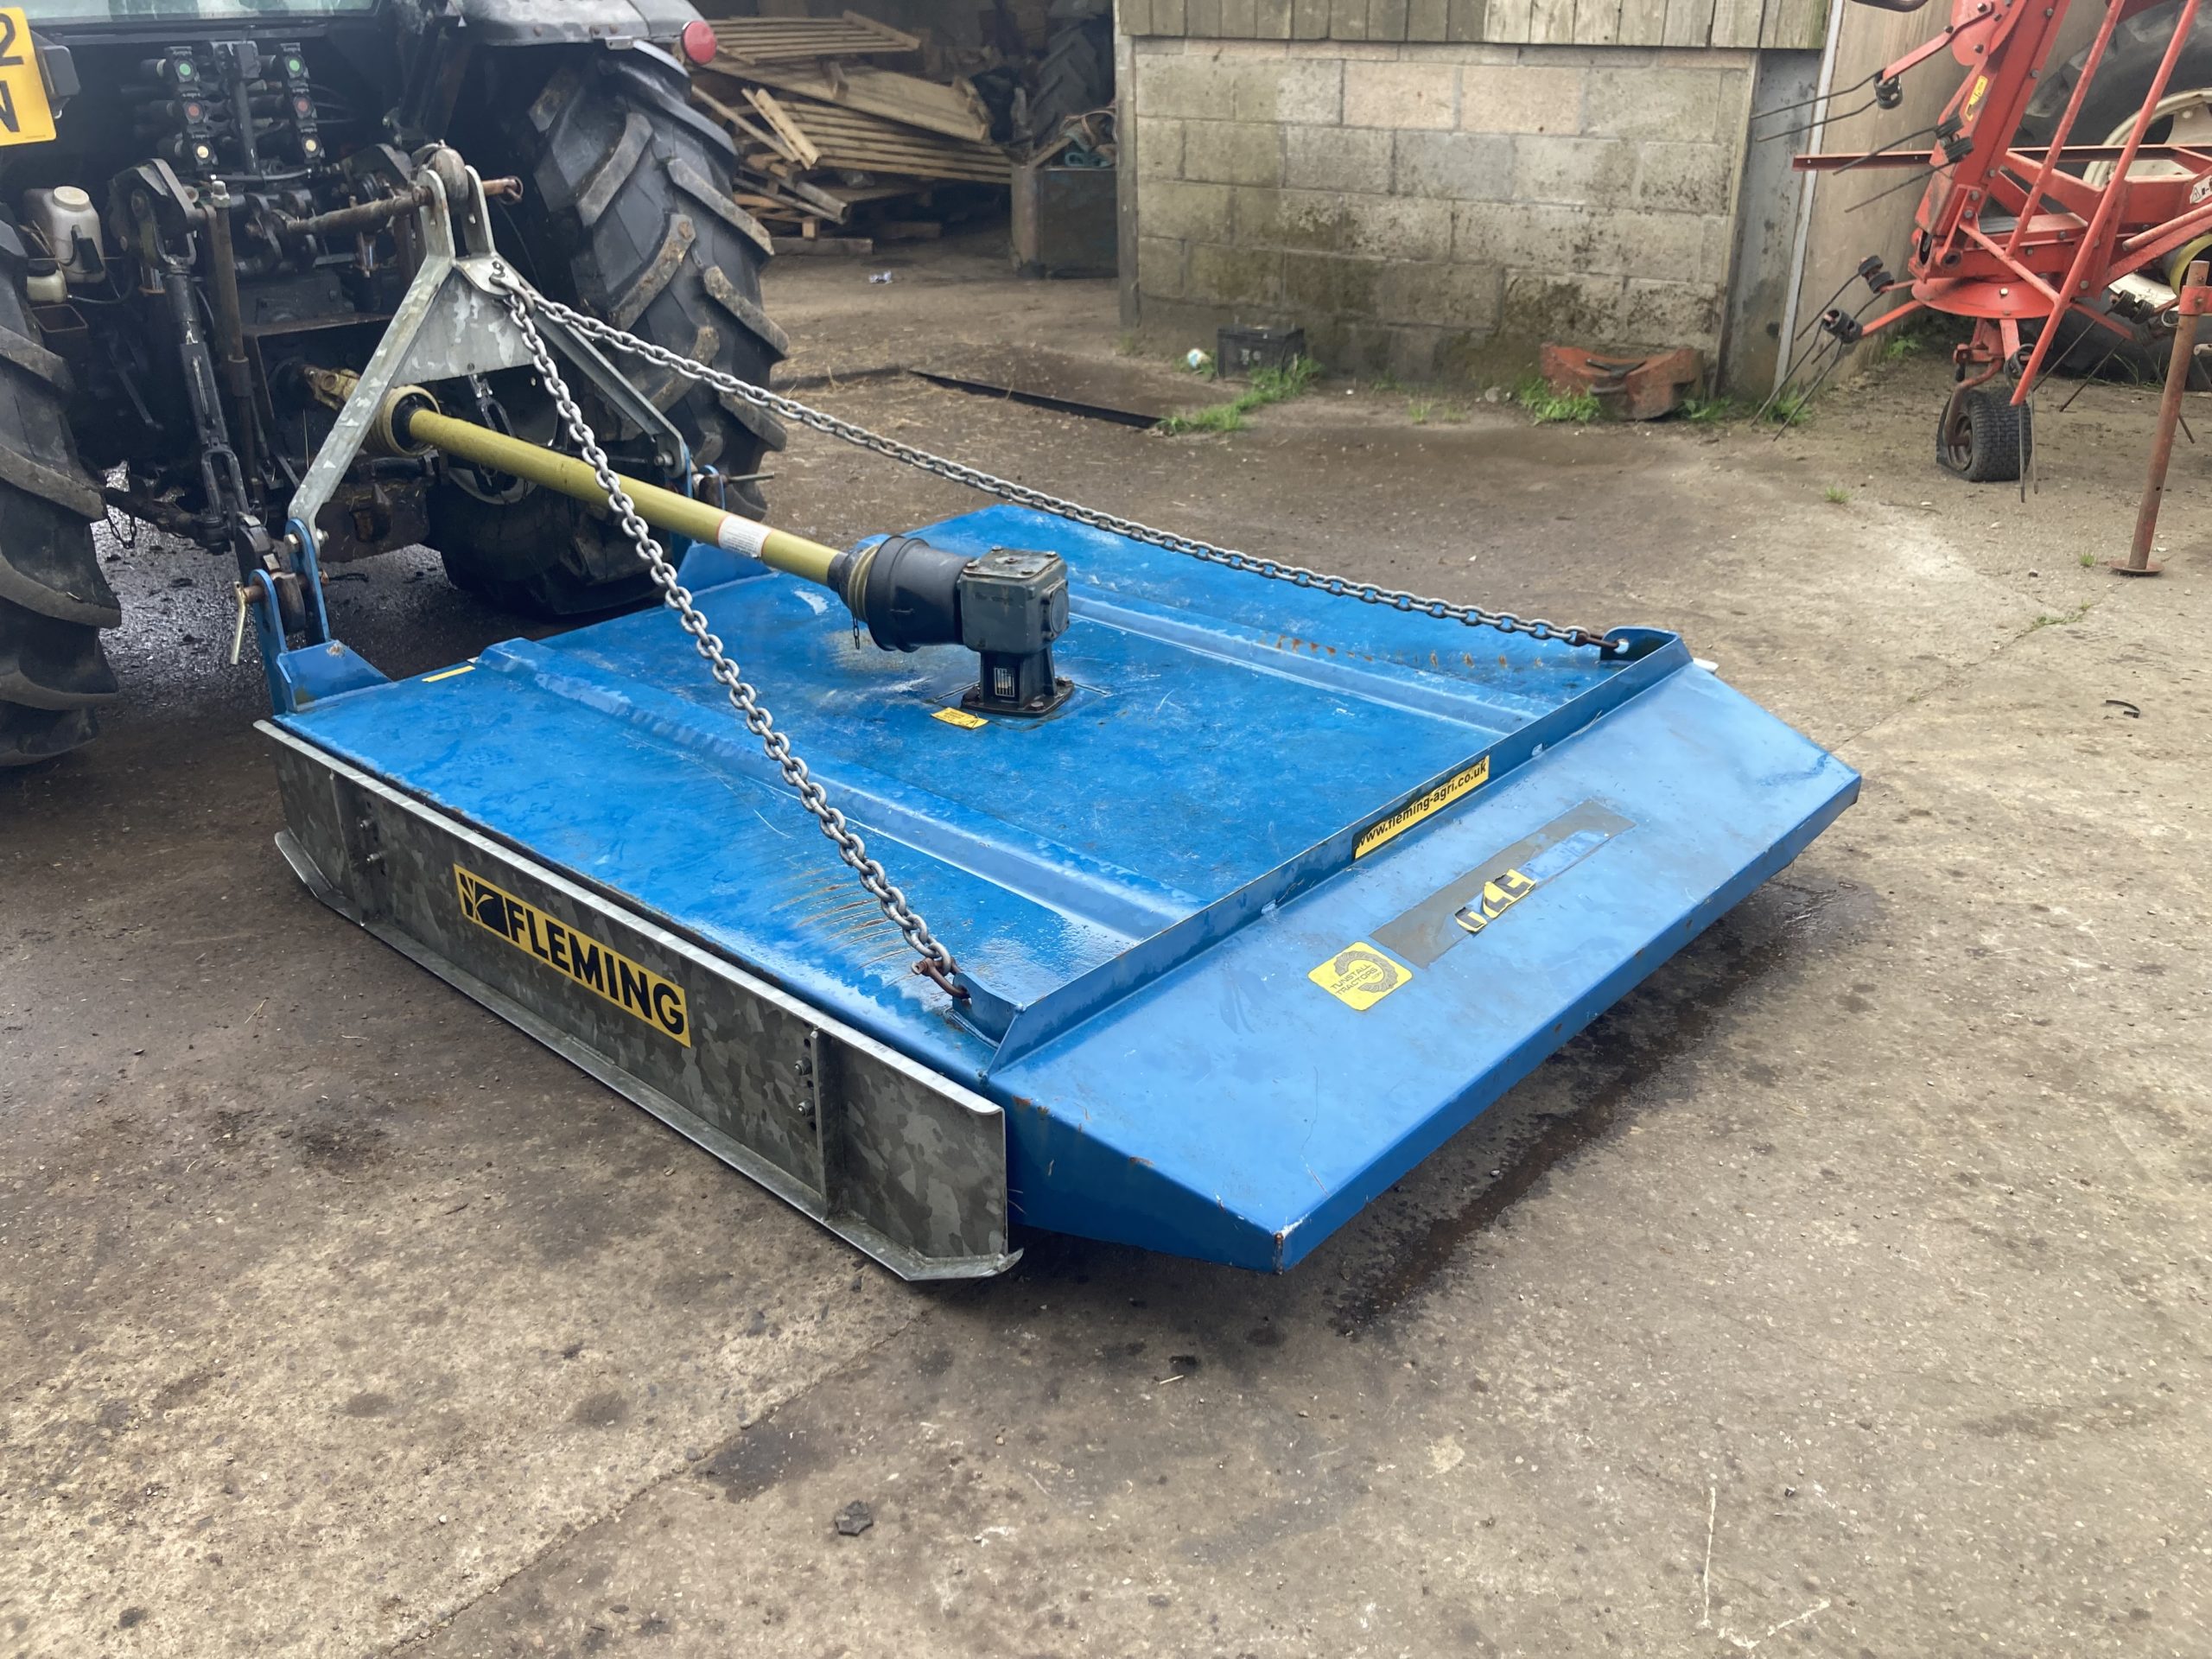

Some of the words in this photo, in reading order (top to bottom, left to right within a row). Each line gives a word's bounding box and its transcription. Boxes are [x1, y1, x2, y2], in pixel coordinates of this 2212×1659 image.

[505, 897, 685, 1035] FLEMING
[1330, 963, 1372, 989] TUNSTALL
[1335, 967, 1378, 995] TRACTORS
